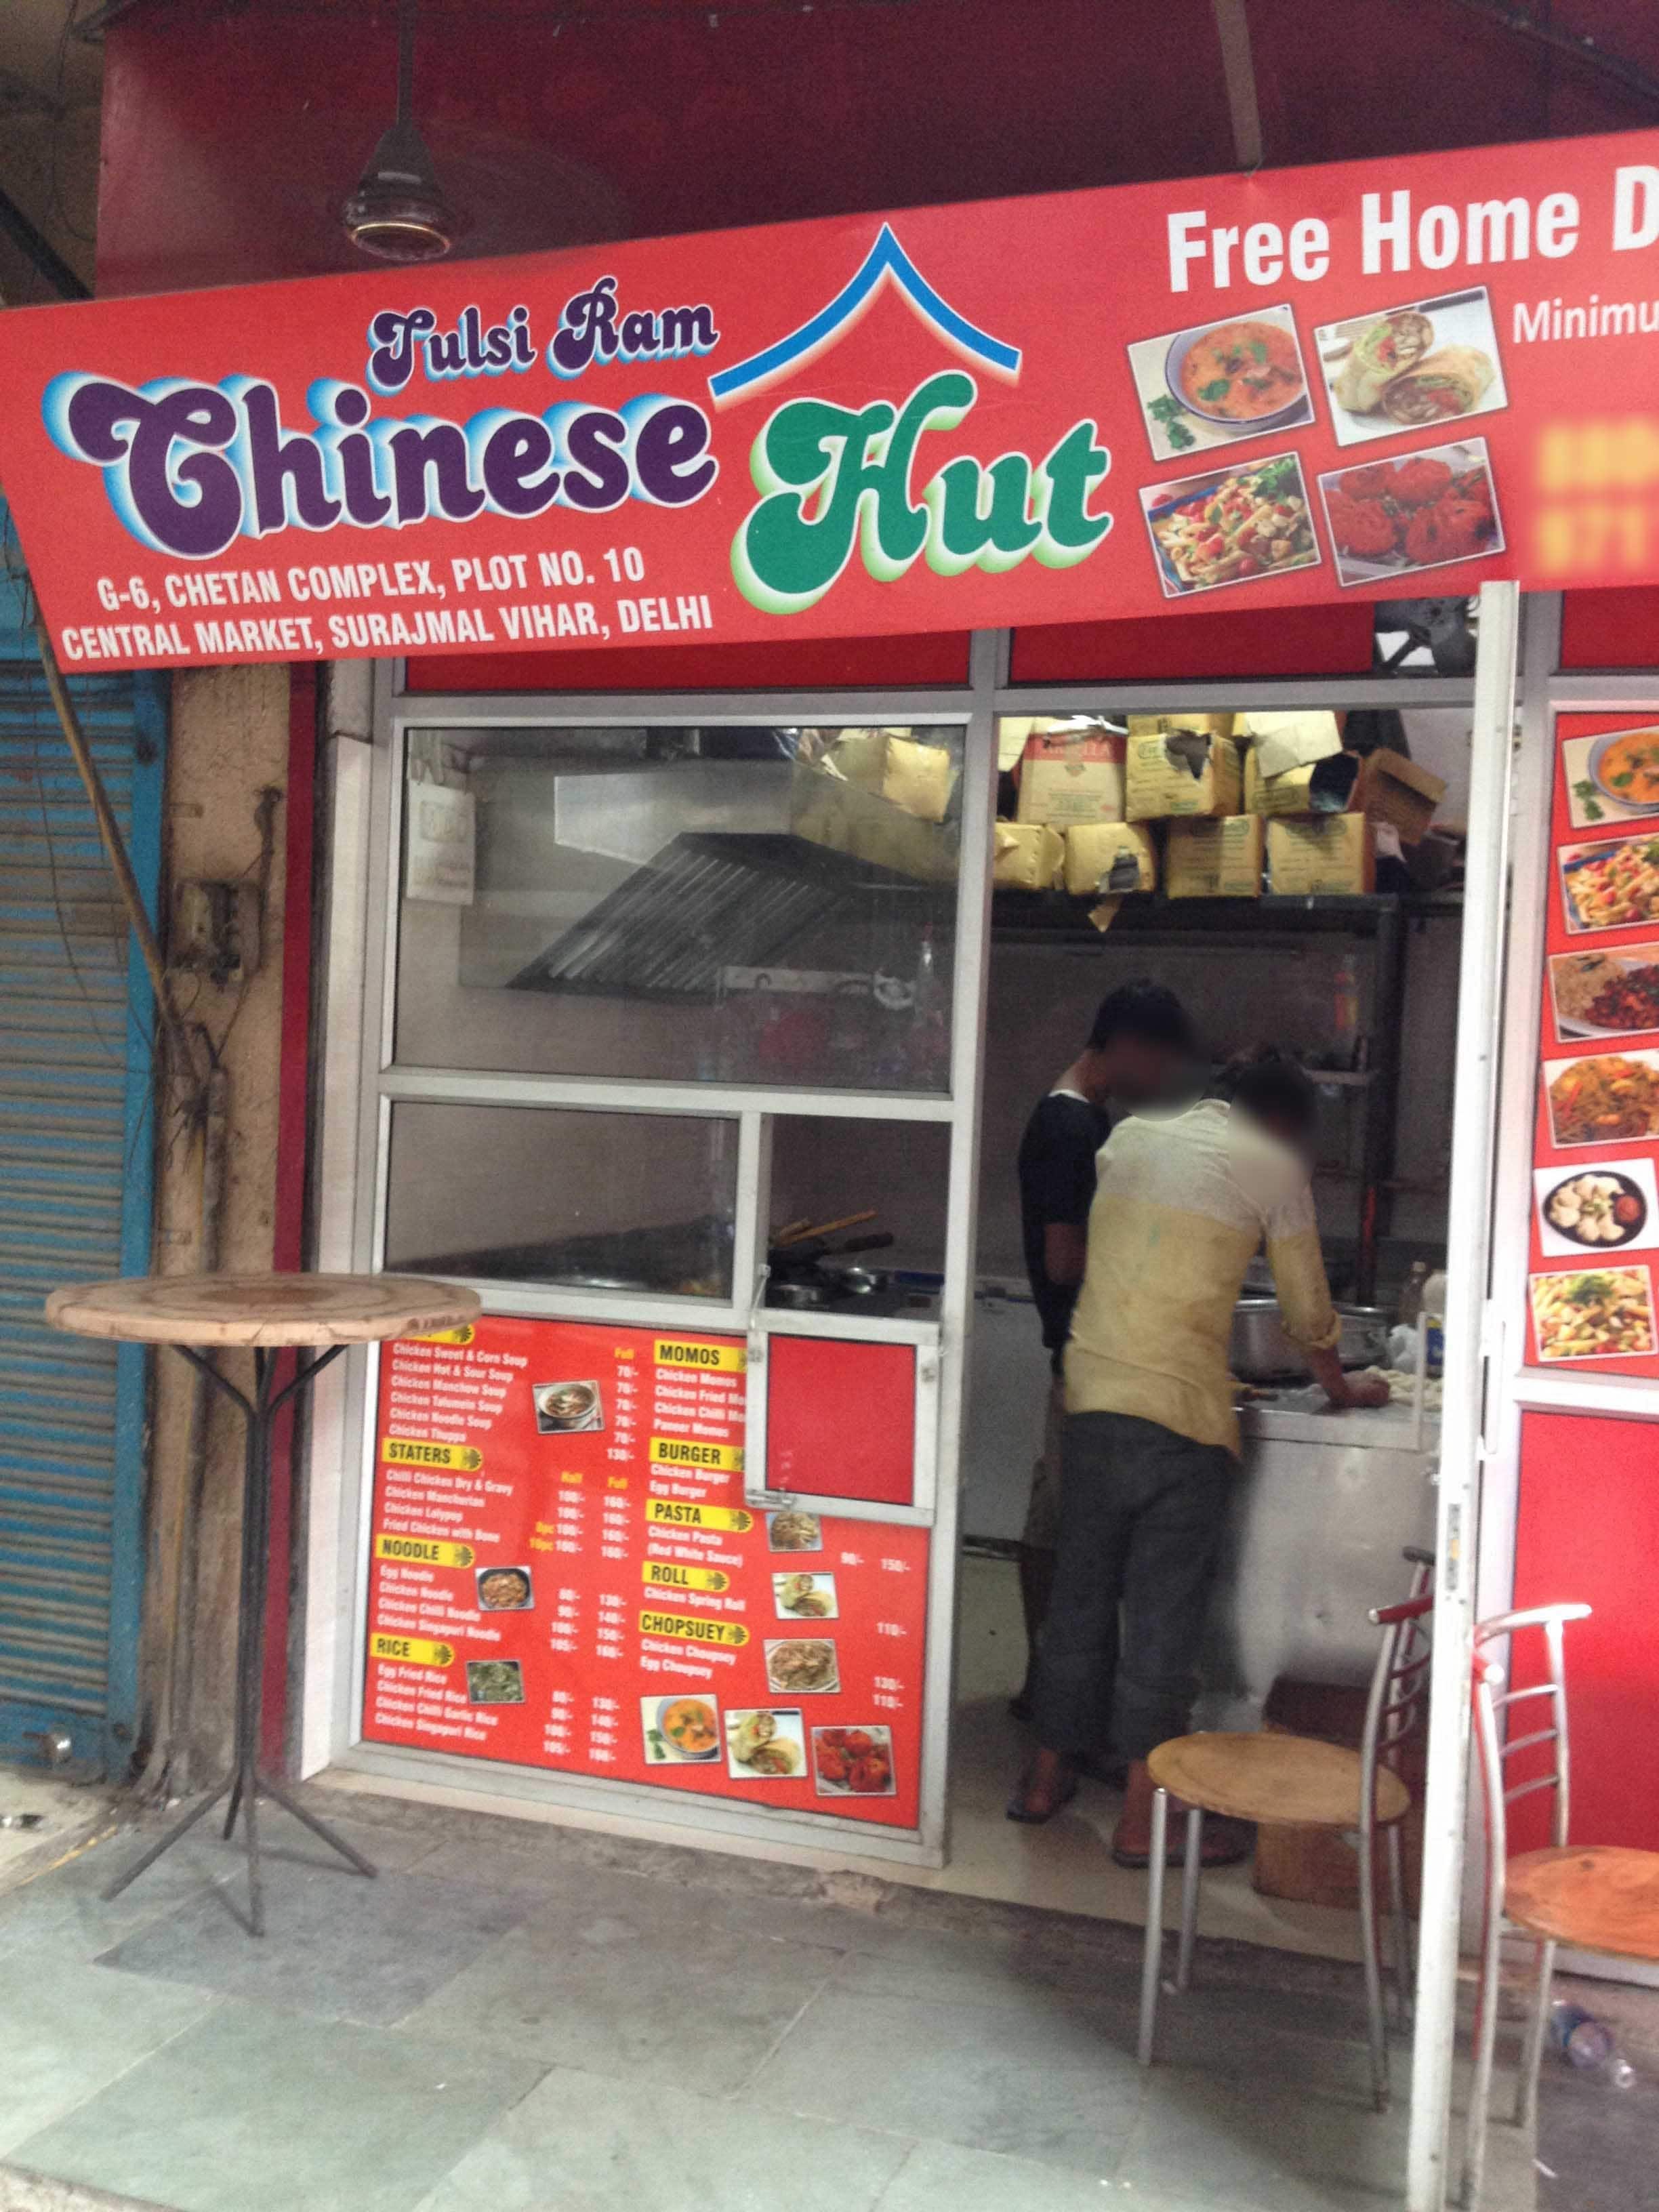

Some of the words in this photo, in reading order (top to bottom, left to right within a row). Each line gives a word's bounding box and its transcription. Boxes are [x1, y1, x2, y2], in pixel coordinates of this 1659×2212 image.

[1167, 210, 1330, 293] Free
[1361, 190, 1580, 275] Home
[367, 305, 536, 396] Tulsi
[547, 276, 720, 380] Ram
[42, 370, 719, 559] Chinese
[730, 369, 1113, 615] Hut
[96, 577, 161, 614] G-6,
[165, 569, 282, 608] CHETAN
[288, 560, 446, 601] COMPLEX,
[451, 554, 527, 594] PLOT
[538, 550, 594, 587] NO.
[603, 547, 644, 582] 10
[62, 623, 190, 660] CENTRAL
[194, 617, 323, 654] MARKET,
[328, 608, 493, 649] SURAJMAL
[498, 602, 609, 640] VIHAR,
[617, 594, 713, 633] DELHI
[394, 1343, 431, 1356] Chicken
[660, 1345, 720, 1365] MOMOS
[393, 1359, 431, 1373] Chicken
[389, 1443, 451, 1464] STATERS
[659, 1443, 720, 1465] BURGER
[655, 1503, 701, 1523] PASTA
[383, 1539, 439, 1560] NOODLE
[651, 1565, 689, 1584] ROLL
[642, 1614, 724, 1641] CHOPSUEY
[377, 1638, 411, 1656] RICE
